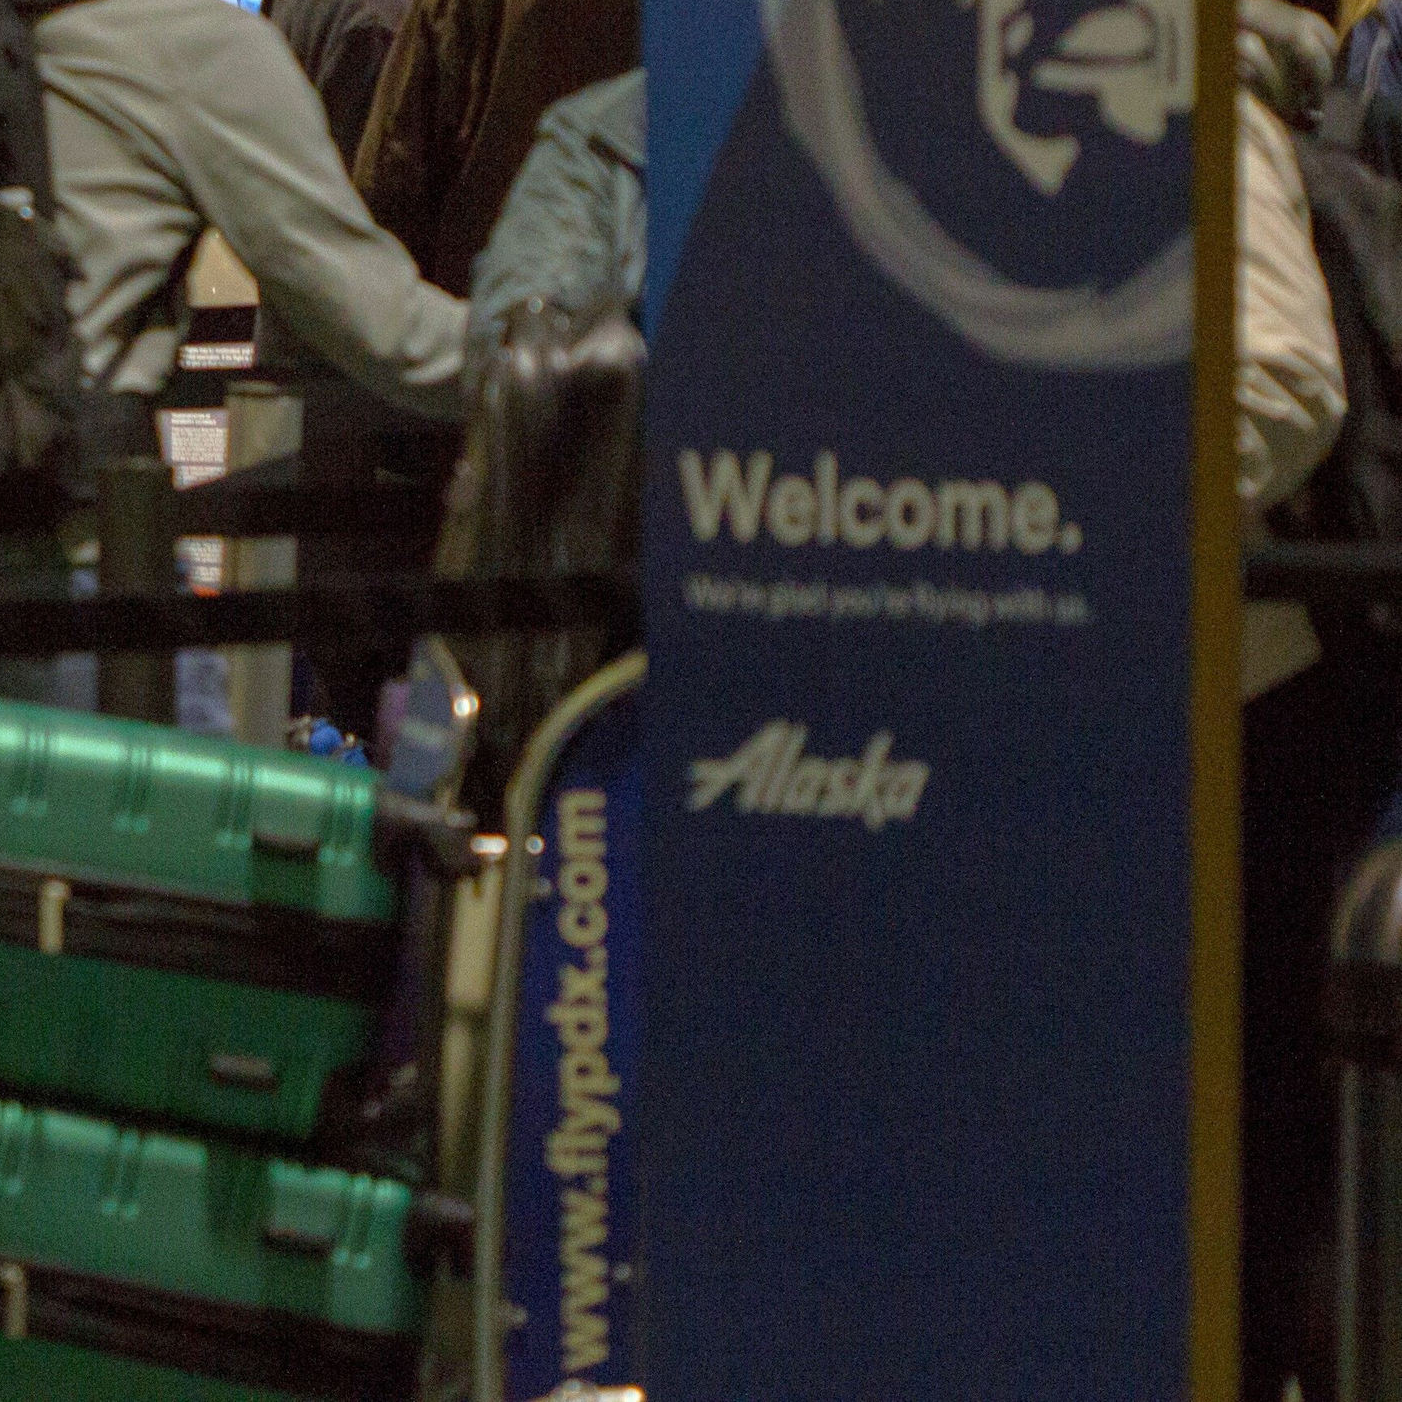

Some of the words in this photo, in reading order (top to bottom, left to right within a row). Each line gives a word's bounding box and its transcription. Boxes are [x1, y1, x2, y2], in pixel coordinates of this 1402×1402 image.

[677, 447, 1084, 557] Welcome.
[685, 717, 929, 834] Alaska
[545, 788, 622, 1374] www.flypdx.com
